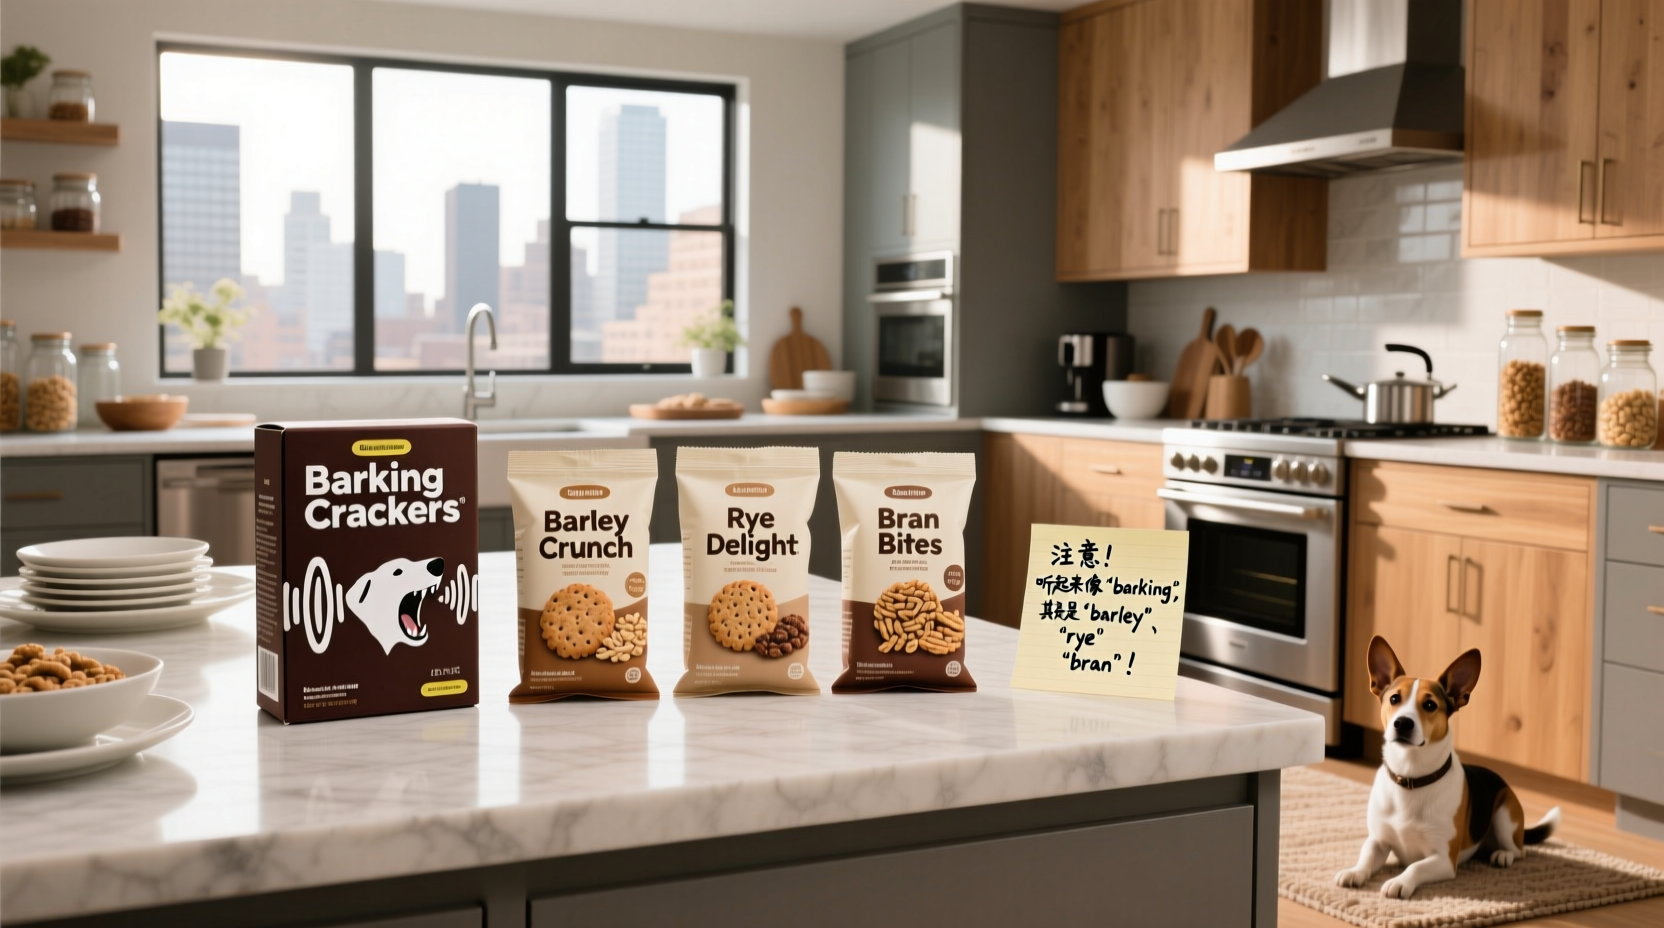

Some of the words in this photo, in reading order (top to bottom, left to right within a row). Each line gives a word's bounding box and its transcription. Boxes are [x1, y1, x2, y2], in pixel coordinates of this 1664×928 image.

[305, 461, 443, 498] Barking
[545, 510, 630, 537] Barley
[728, 507, 775, 534] Rye
[879, 508, 940, 529] Bran
[539, 536, 633, 559] Crunch
[707, 533, 799, 562] Delight
[879, 532, 943, 555] Bites
[1051, 539, 1112, 569] 注意！
